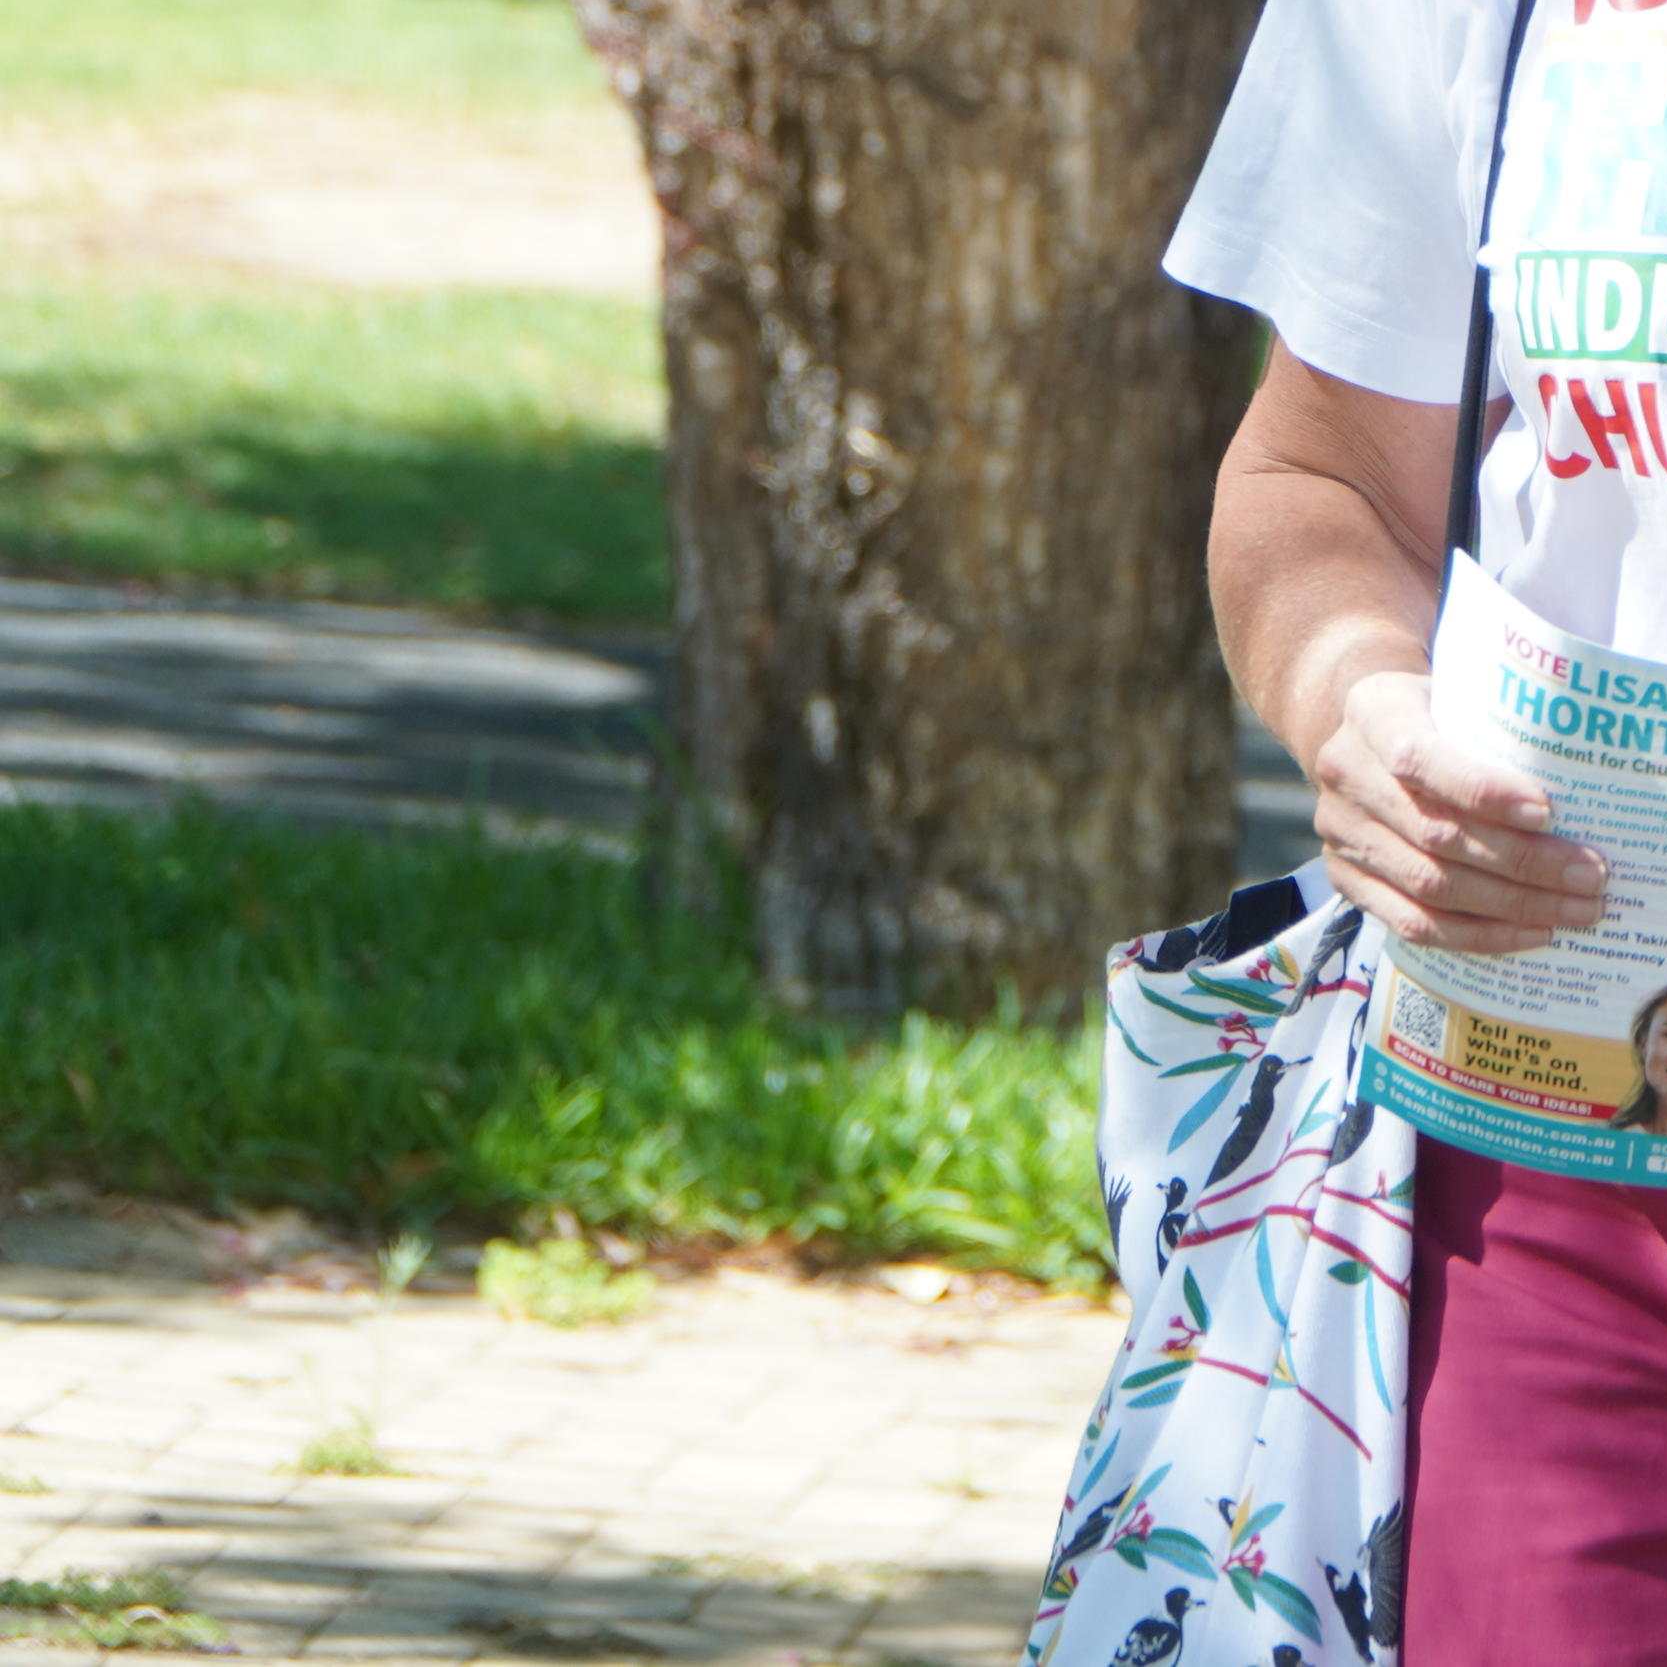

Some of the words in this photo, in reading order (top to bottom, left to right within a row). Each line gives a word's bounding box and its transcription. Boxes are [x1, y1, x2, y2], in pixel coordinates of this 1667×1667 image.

[1504, 622, 1570, 679] VOTE
[1488, 712, 1595, 765] Independent
[1600, 752, 1628, 771] for
[1570, 778, 1602, 792] your
[1564, 812, 1595, 825] puts
[1585, 830, 1618, 845] from
[1621, 838, 1659, 854] party
[1602, 893, 1646, 908] Crisis
[1602, 929, 1629, 942] and
[1567, 940, 1665, 967] Transparency
[1519, 958, 1551, 971] work
[1556, 965, 1584, 978] with
[1588, 972, 1613, 985] you
[1616, 974, 1630, 985] to
[1521, 973, 1554, 986] even
[1558, 977, 1598, 993] better
[1451, 977, 1498, 1002] matters
[1502, 994, 1516, 1006] to
[1498, 980, 1519, 993] the
[1522, 985, 1544, 999] QR
[1548, 990, 1582, 1005] code
[1585, 995, 1600, 1008] to
[1468, 1015, 1509, 1041] Tell
[1517, 1032, 1553, 1051] me
[1466, 1035, 1541, 1066] what's
[1549, 1057, 1579, 1074] on
[1393, 1041, 1427, 1067] SCAN
[1429, 1061, 1448, 1077] TO
[1450, 1070, 1496, 1094] SHARE
[1500, 1086, 1540, 1106] YOUR
[1543, 1098, 1593, 1116] IDEAS!
[1464, 1051, 1516, 1076] your
[1522, 1068, 1589, 1093] mind.
[1391, 1072, 1616, 1150] www.LisaThornton.com.au
[1390, 1087, 1615, 1168] team@lisathornton.com.au
